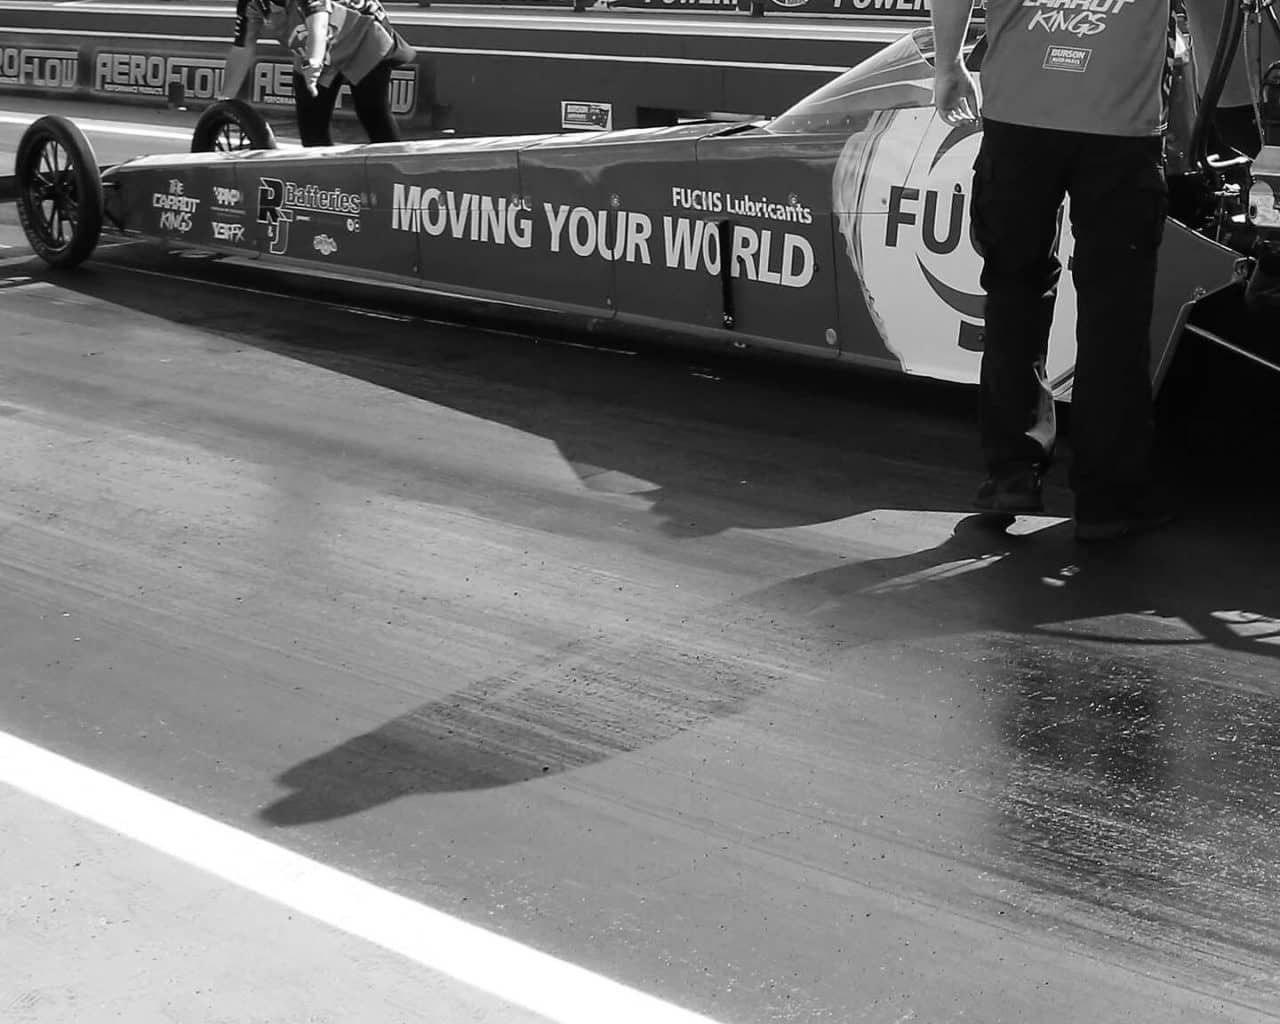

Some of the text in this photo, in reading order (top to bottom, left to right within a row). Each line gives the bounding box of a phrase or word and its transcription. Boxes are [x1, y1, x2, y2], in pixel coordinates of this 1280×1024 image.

[1027, 9, 1107, 38] KINGS
[0, 47, 79, 88] OFLOW
[95, 52, 227, 99] AEROFLOW
[153, 192, 200, 213] CARROT
[285, 181, 361, 214] Batteries
[725, 192, 814, 225] Lubricants
[391, 183, 816, 288] MOVING YOUR WORLD
